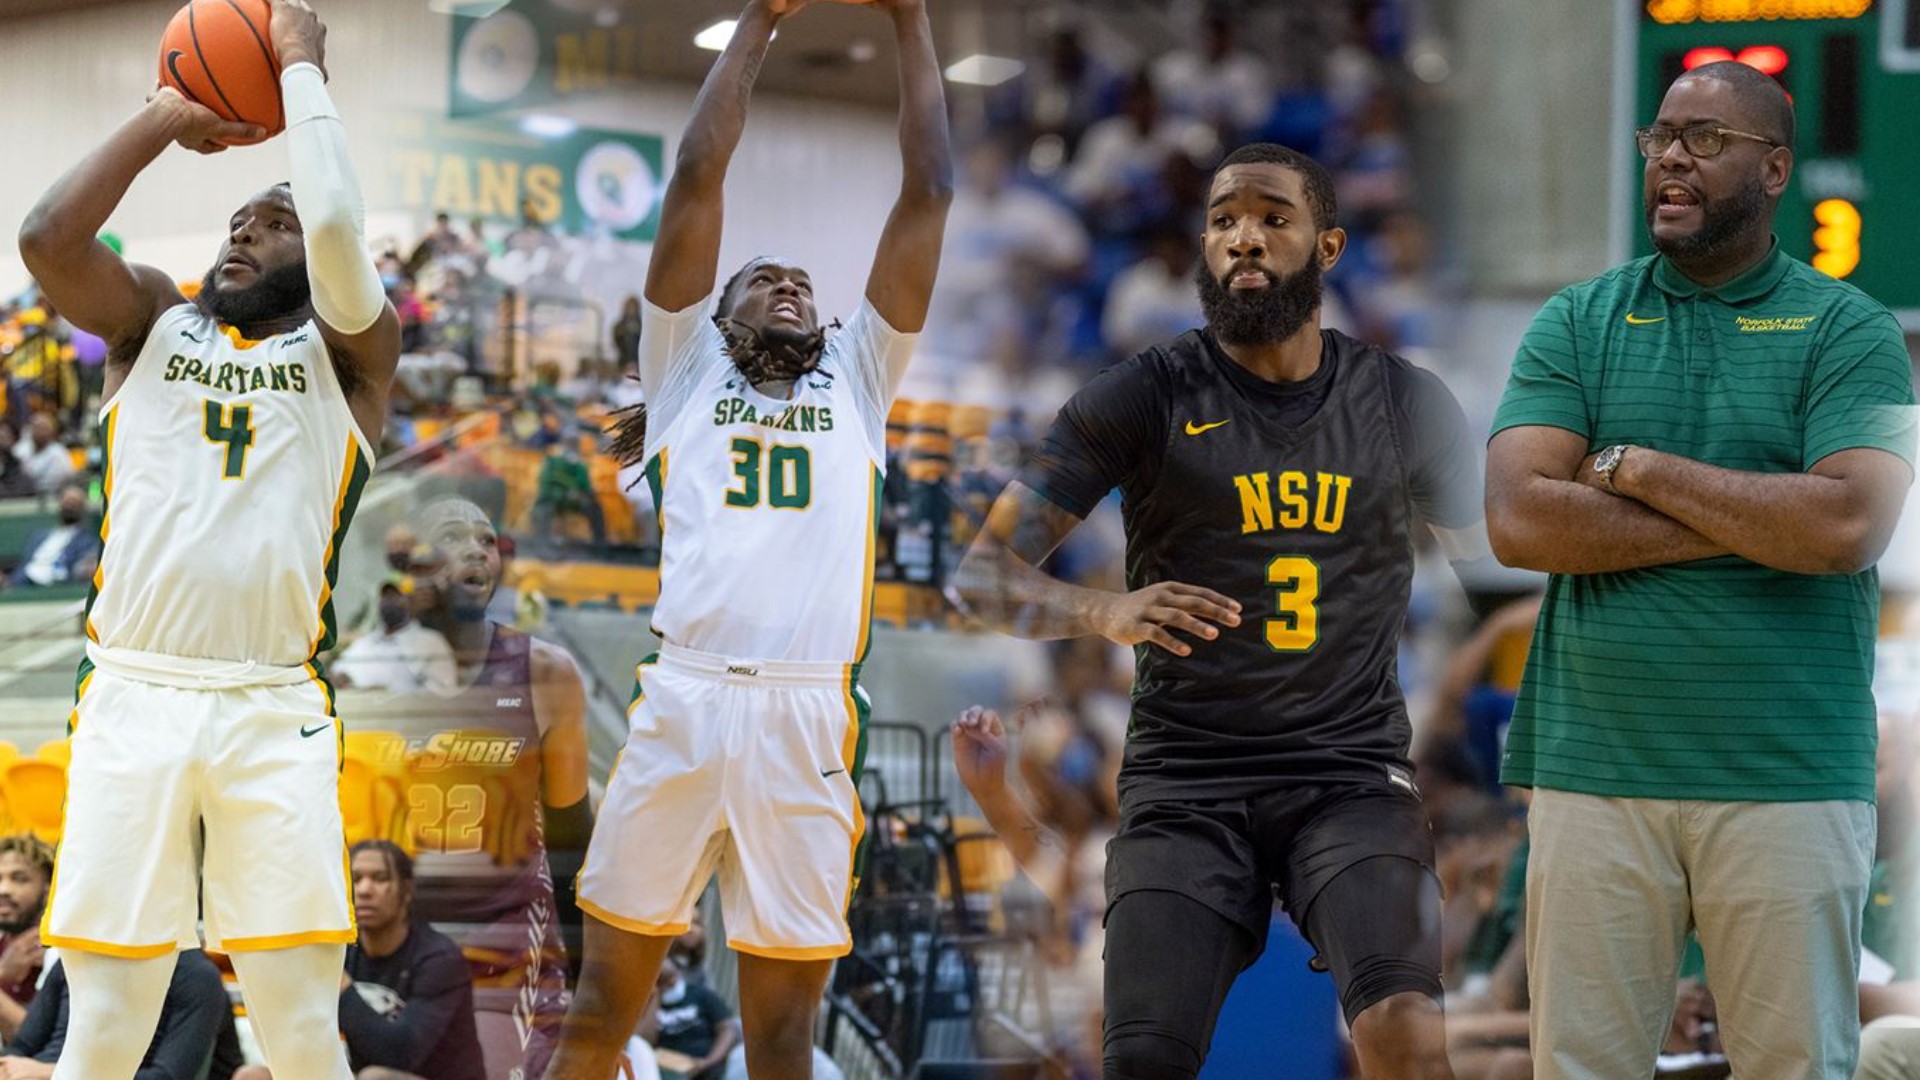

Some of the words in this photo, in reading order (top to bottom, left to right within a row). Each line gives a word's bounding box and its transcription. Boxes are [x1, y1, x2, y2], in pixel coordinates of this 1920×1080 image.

[1811, 198, 1862, 280] 3
[1741, 323, 1807, 332] BASKETBALL
[164, 353, 307, 394] SPARTANS
[201, 398, 257, 480] 4
[724, 435, 812, 512] 30
[1233, 470, 1353, 535] NSU
[1263, 553, 1322, 653] 3
[727, 666, 758, 676] NSU
[374, 739, 424, 763] THE
[416, 732, 521, 769] SHORE
[406, 784, 487, 854] 22
